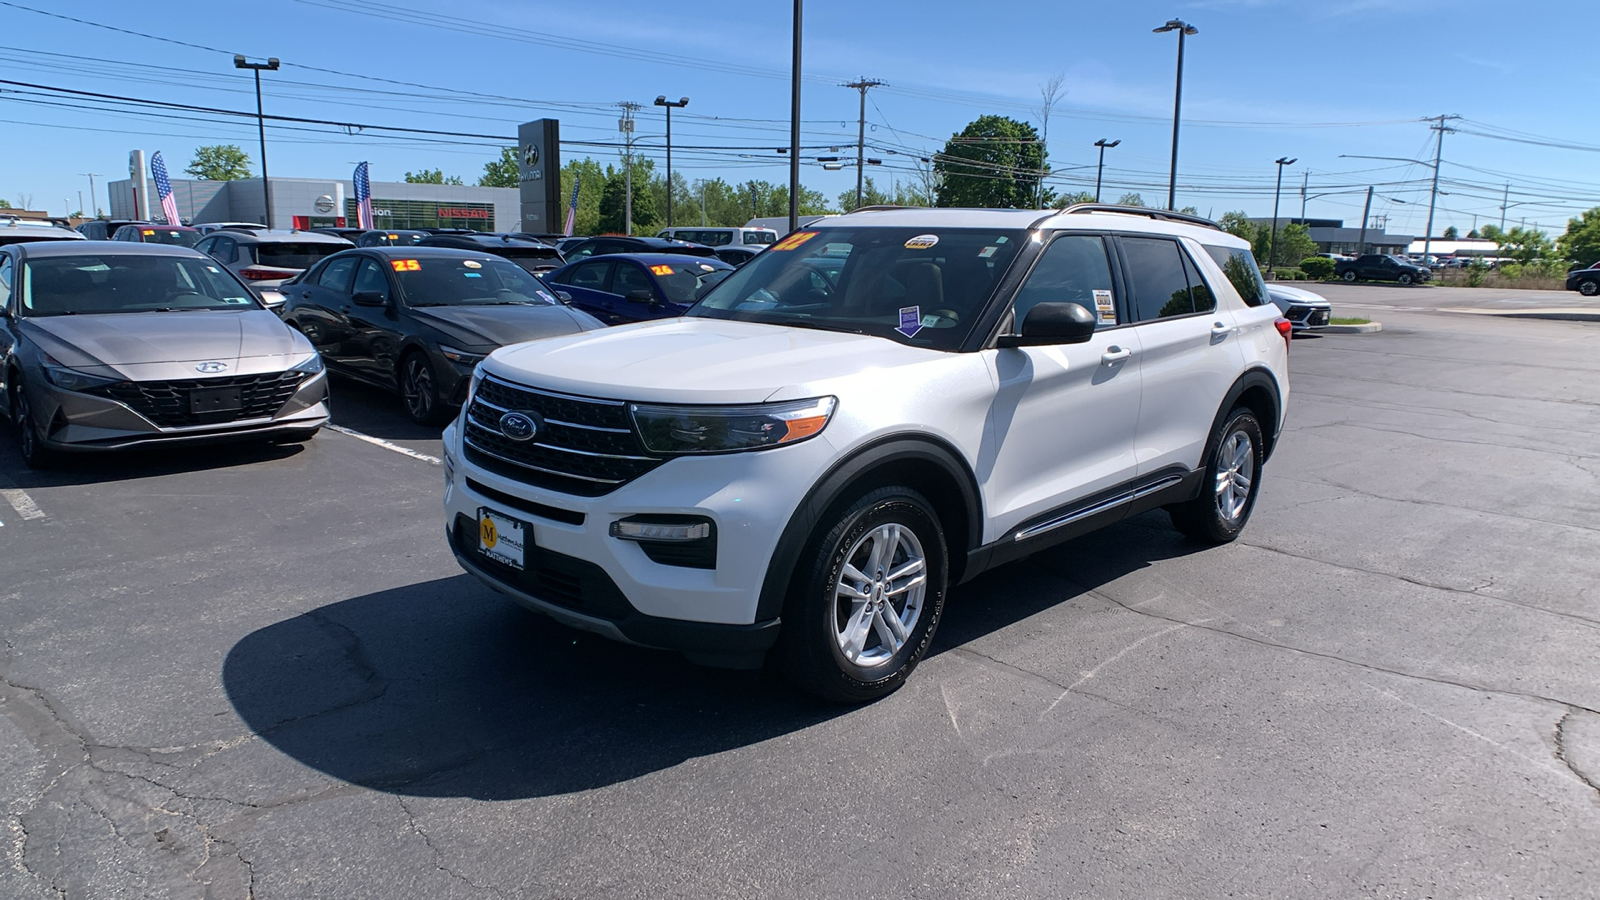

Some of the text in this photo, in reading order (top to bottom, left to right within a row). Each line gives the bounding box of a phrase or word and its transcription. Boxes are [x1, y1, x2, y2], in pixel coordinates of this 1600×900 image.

[438, 208, 489, 219] NISSAN
[773, 232, 816, 250] 22
[392, 260, 420, 271] 25
[651, 264, 674, 275] 26
[507, 417, 527, 435] Ford
[483, 524, 494, 543] M
